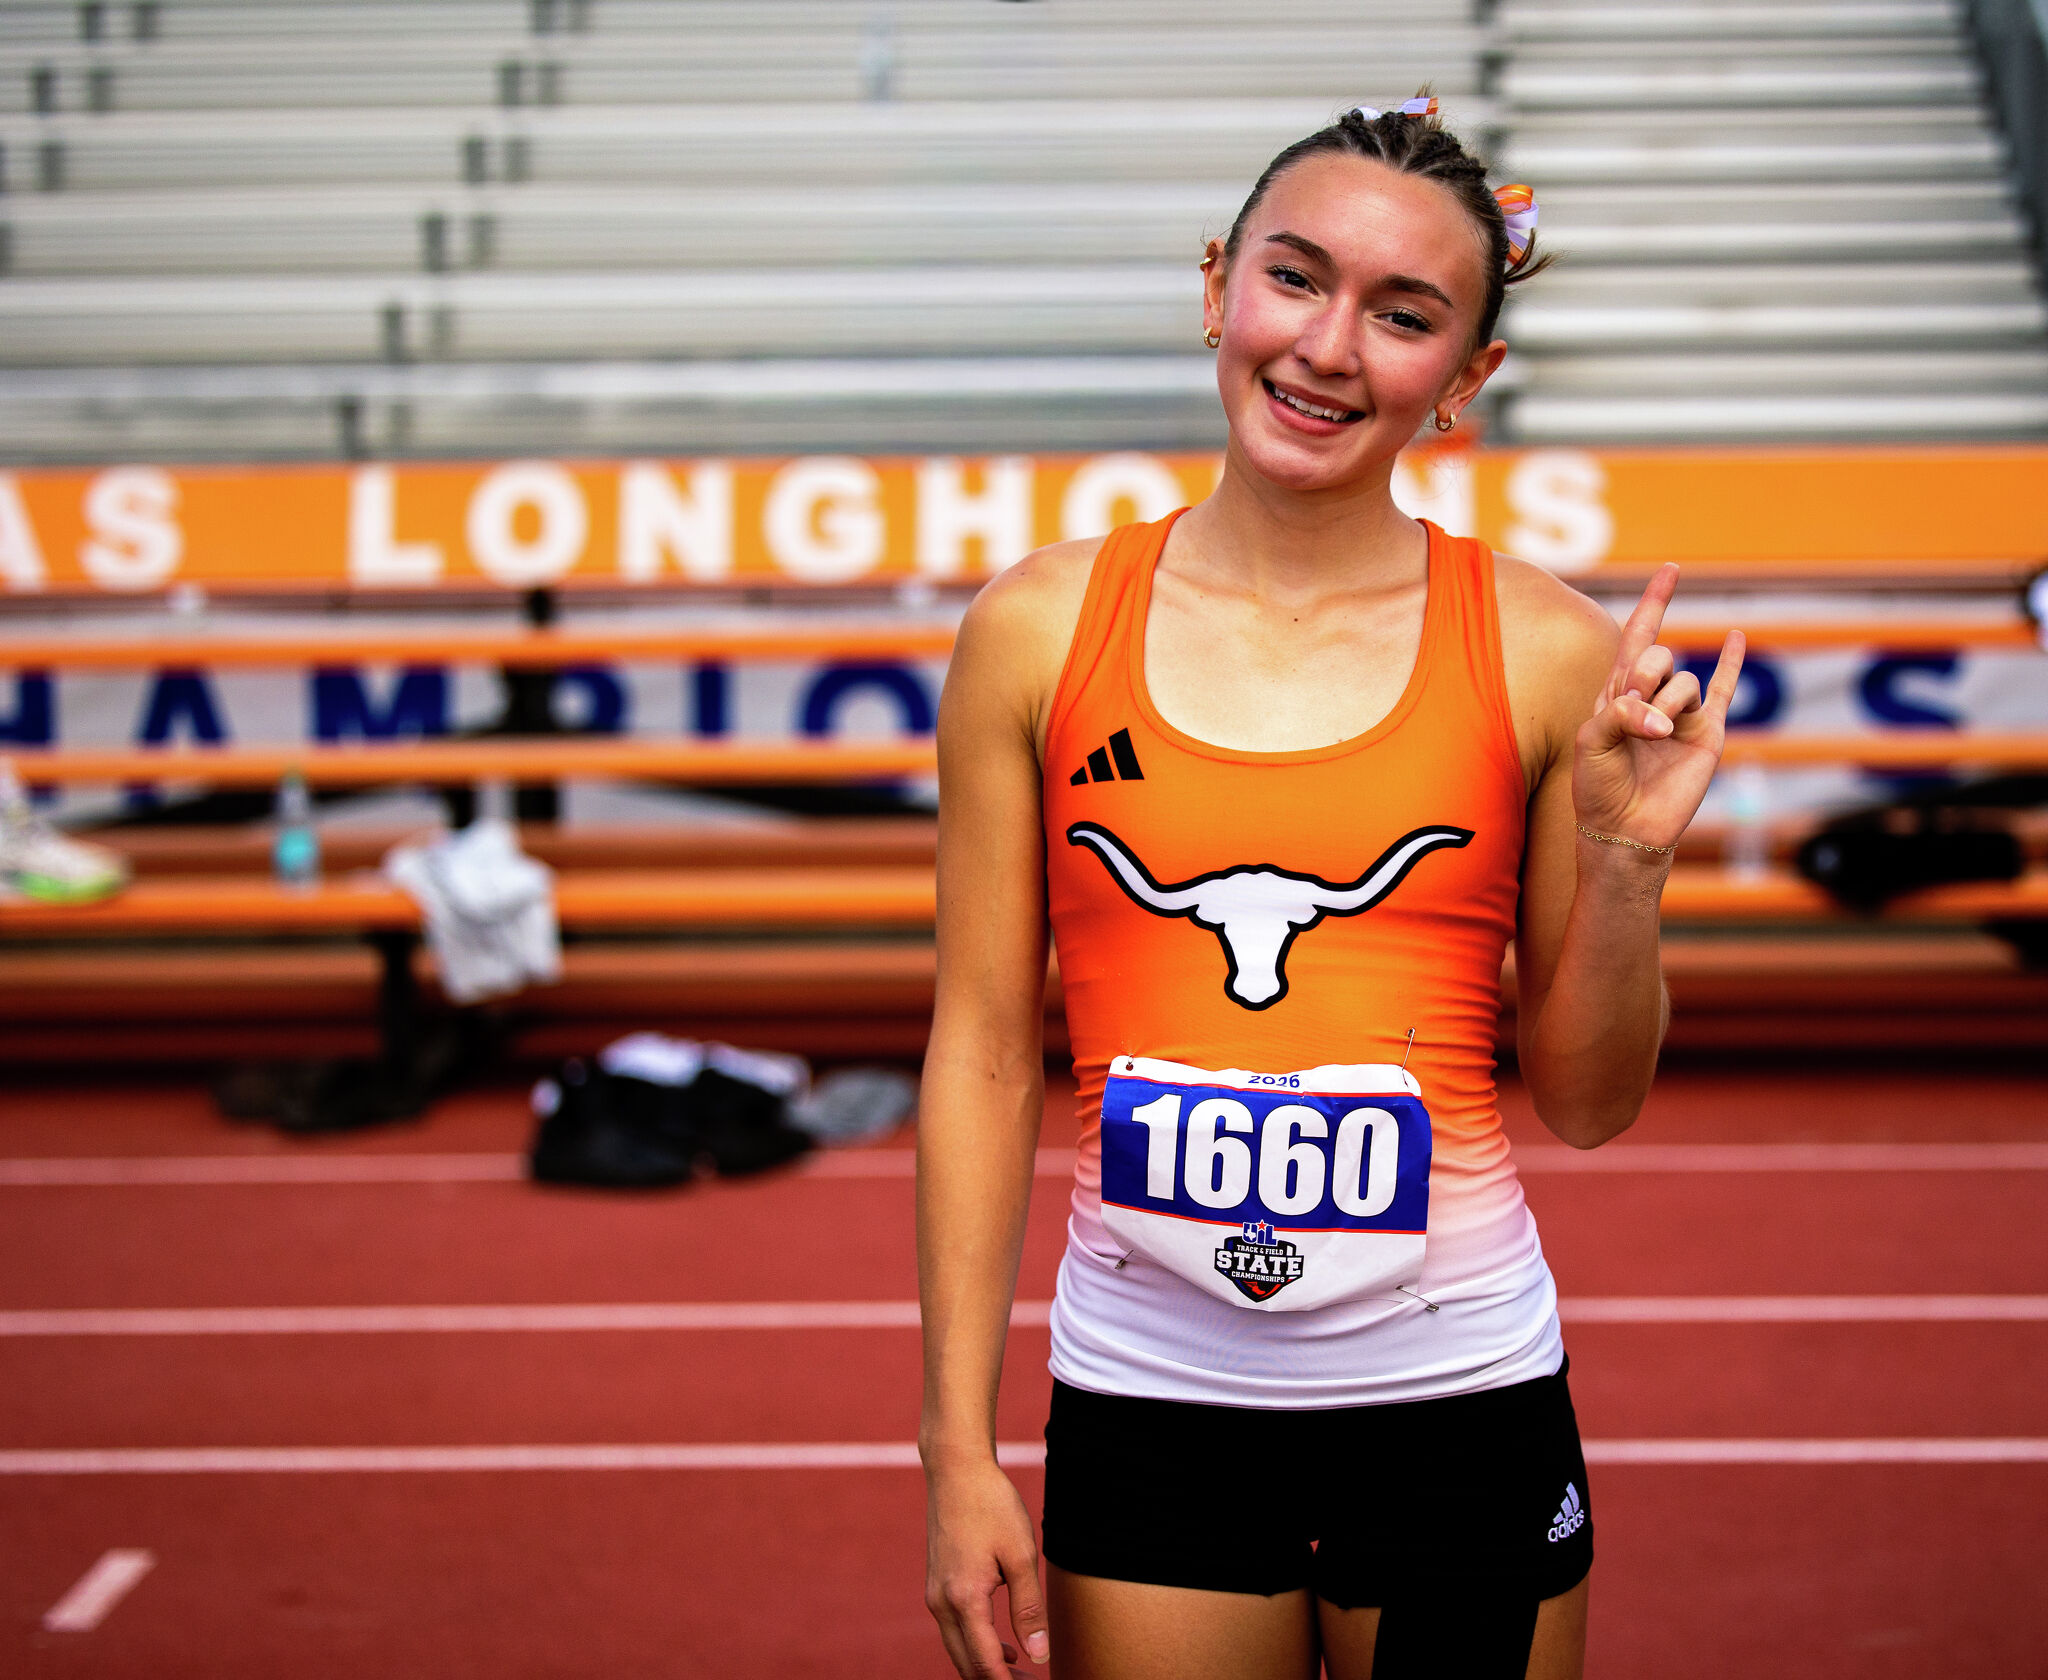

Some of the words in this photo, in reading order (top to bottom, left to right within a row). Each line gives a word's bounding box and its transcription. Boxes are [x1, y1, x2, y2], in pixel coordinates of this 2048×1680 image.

[1131, 1093, 1400, 1217] 1660
[1216, 1250, 1302, 1276] STATE
[1236, 1244, 1258, 1254] TRACK
[1265, 1248, 1284, 1256] FIELD
[1231, 1270, 1286, 1283] CHAMPIONSHIPS
[1547, 1509, 1585, 1543] adidas
